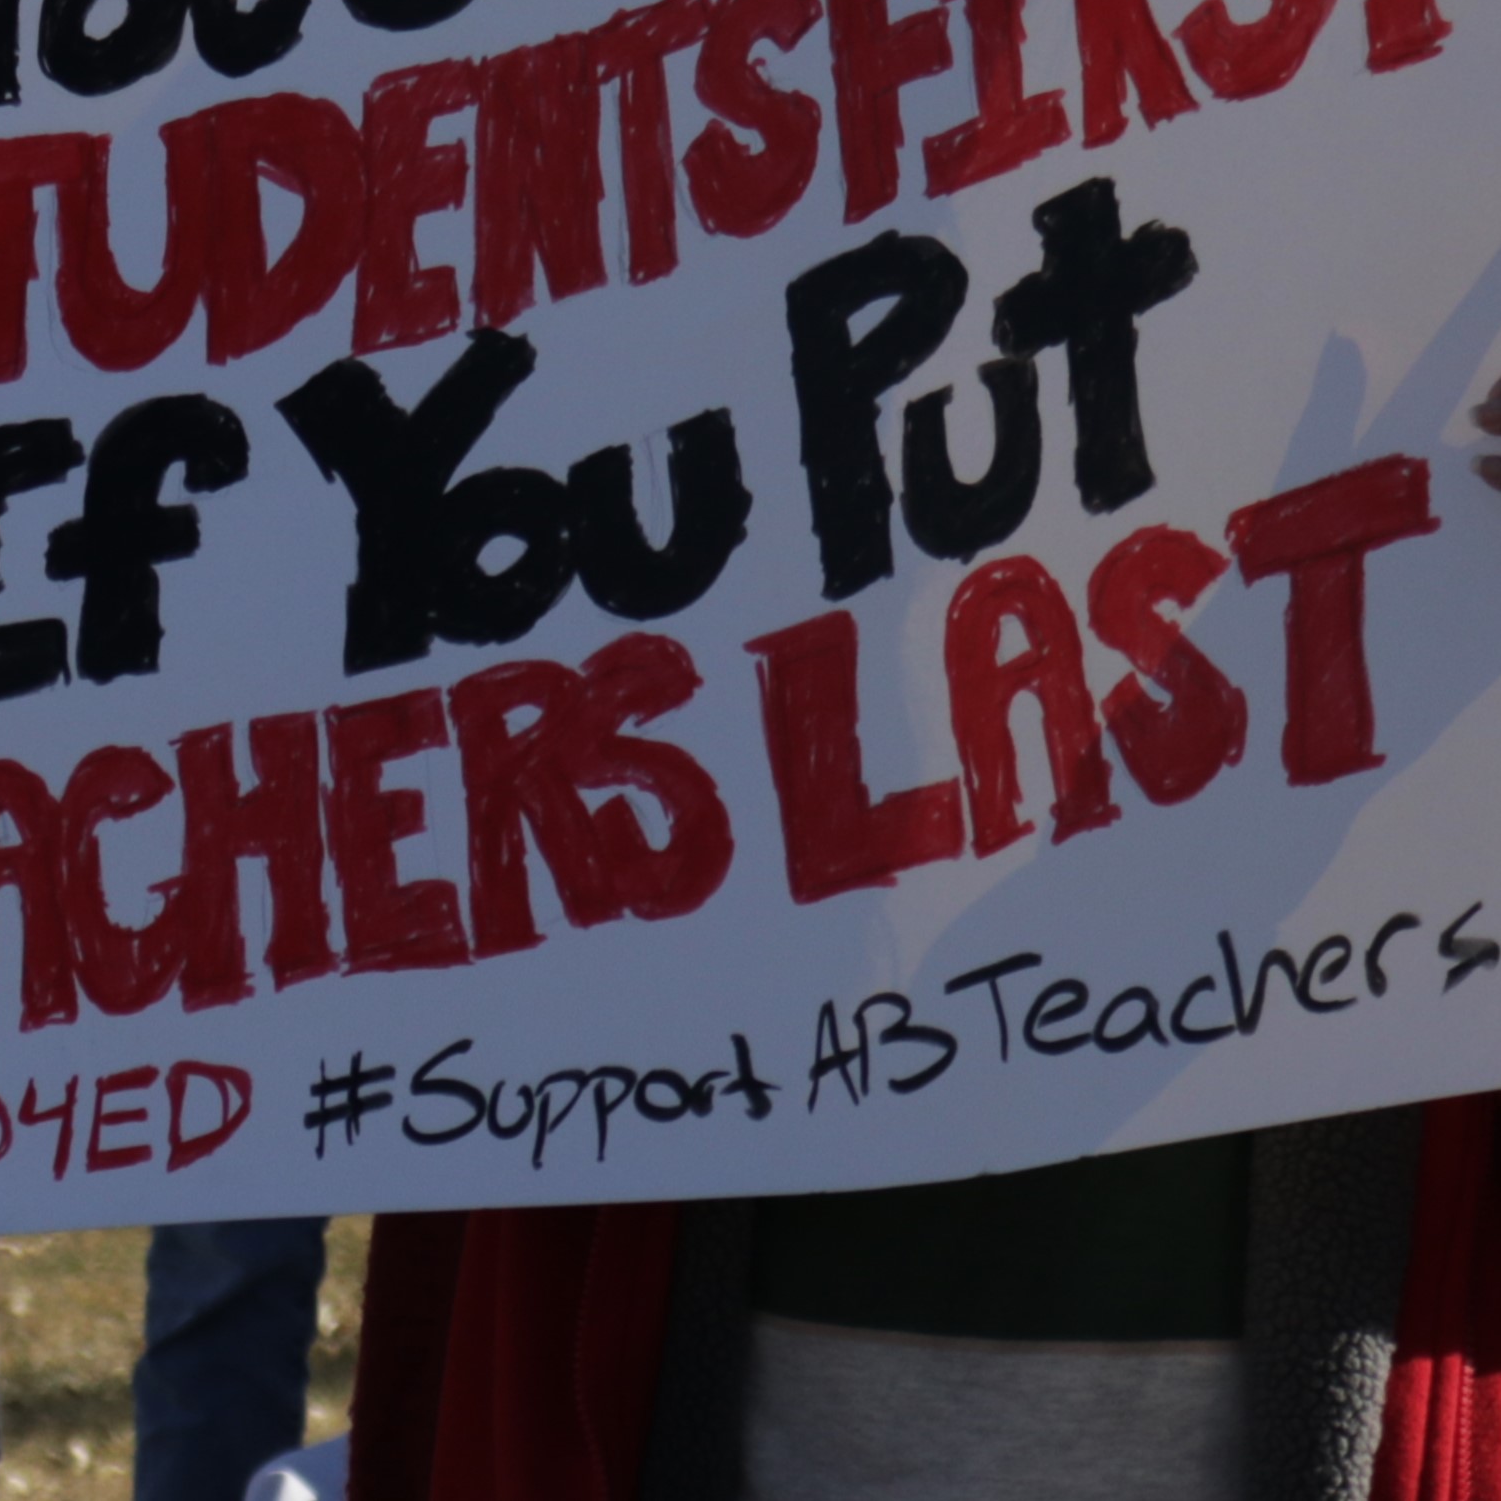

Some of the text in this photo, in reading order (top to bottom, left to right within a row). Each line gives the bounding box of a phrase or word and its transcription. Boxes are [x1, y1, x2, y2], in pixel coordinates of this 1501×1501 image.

[276, 325, 752, 674] You
[786, 178, 1197, 600] Put
[749, 455, 1438, 901] LAST
[303, 1032, 782, 1170] #Support
